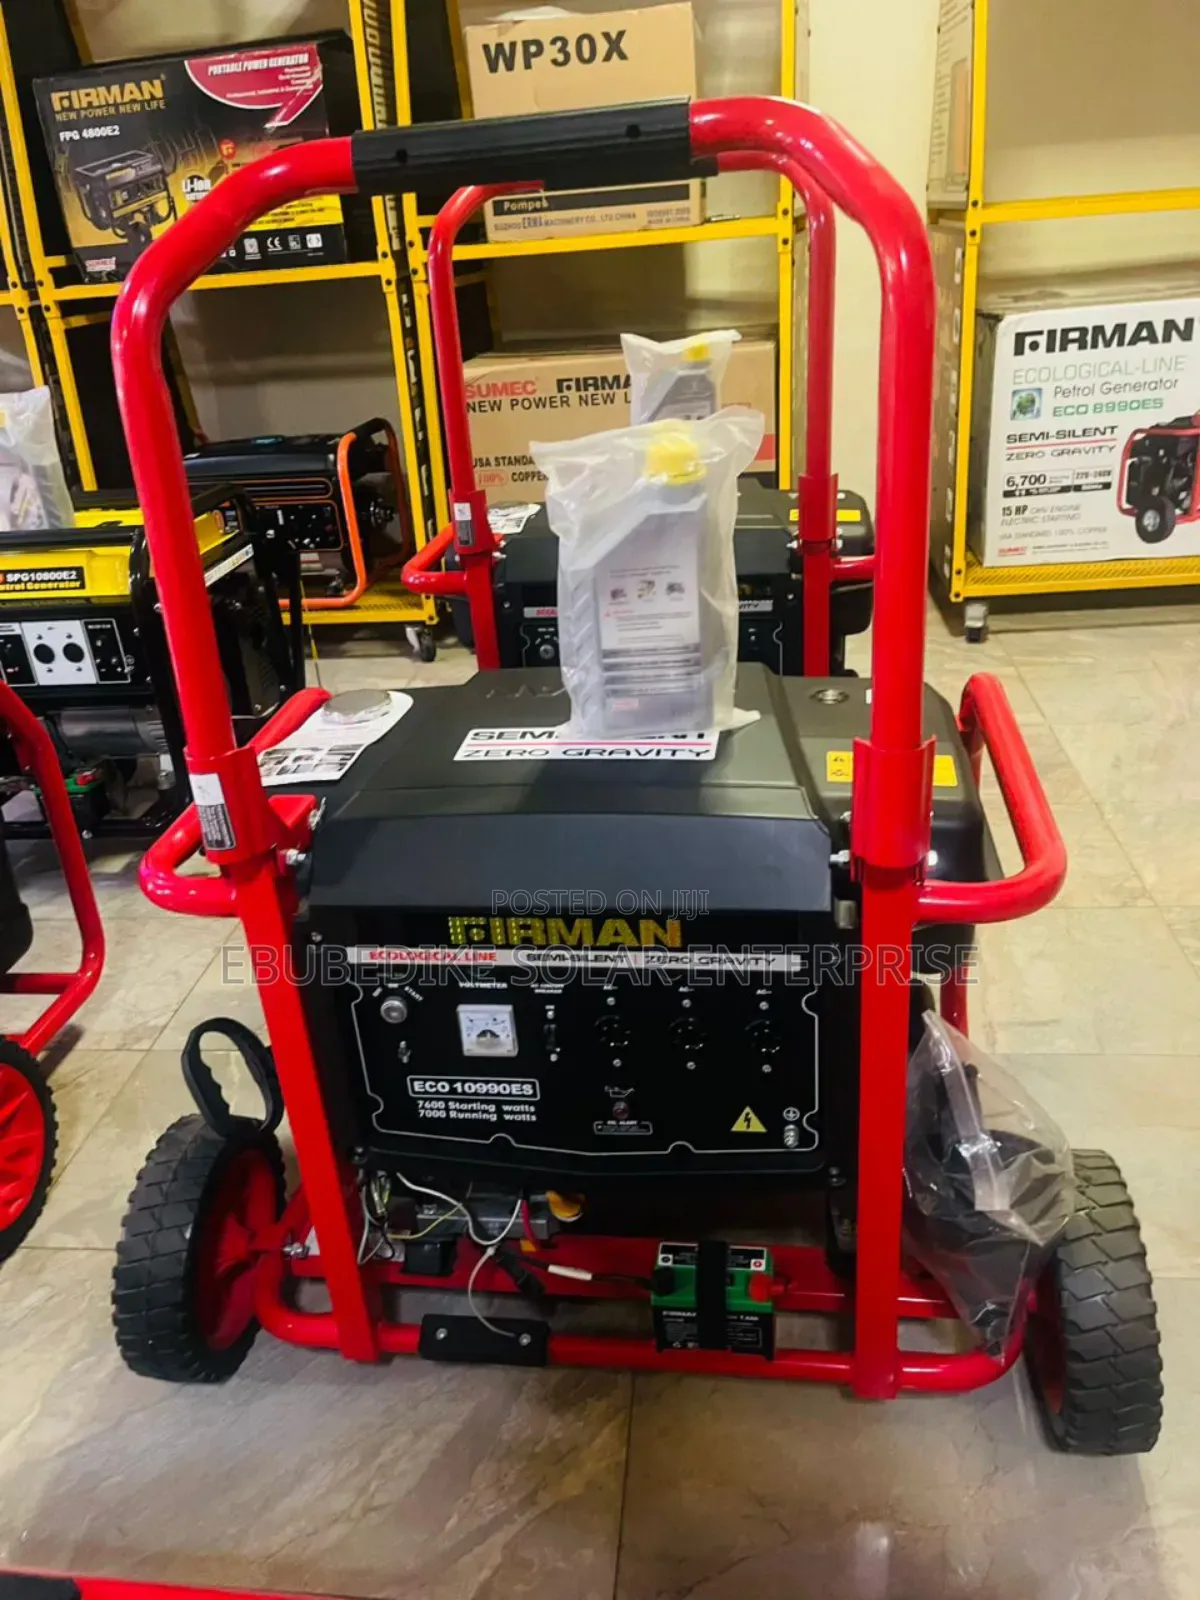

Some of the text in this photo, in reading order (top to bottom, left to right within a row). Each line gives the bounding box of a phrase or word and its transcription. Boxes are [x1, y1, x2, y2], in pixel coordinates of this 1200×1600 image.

[481, 29, 629, 73] WP30X
[50, 79, 163, 112] FIRMAN
[55, 100, 166, 121] NEW POWER NEW LIFE
[59, 130, 80, 141] FPG
[1013, 317, 1195, 357] FIRMAN
[1013, 355, 1189, 385] ECOLOGICAL-LINE
[463, 380, 537, 399] SUMEC
[1054, 378, 1179, 399] Petrol Generator
[466, 400, 502, 413] NEW
[510, 396, 570, 411] POWER
[578, 392, 616, 407] NEW
[1053, 405, 1089, 418] ECO
[1006, 425, 1118, 444] SEMI-SILENT
[494, 454, 535, 467] STANDA
[1006, 445, 1117, 461] ZERO GRAVITY
[1006, 474, 1047, 488] 6,700
[1002, 506, 1012, 516] 15
[1014, 504, 1028, 515] HP
[464, 748, 711, 758] ZERO GRAVITY
[448, 916, 682, 948] FIRMAN
[413, 1080, 534, 1096] ECO 10990ES
[417, 1100, 535, 1112] 7600 Starting watts
[418, 1109, 537, 1122] 7000 Running watts
